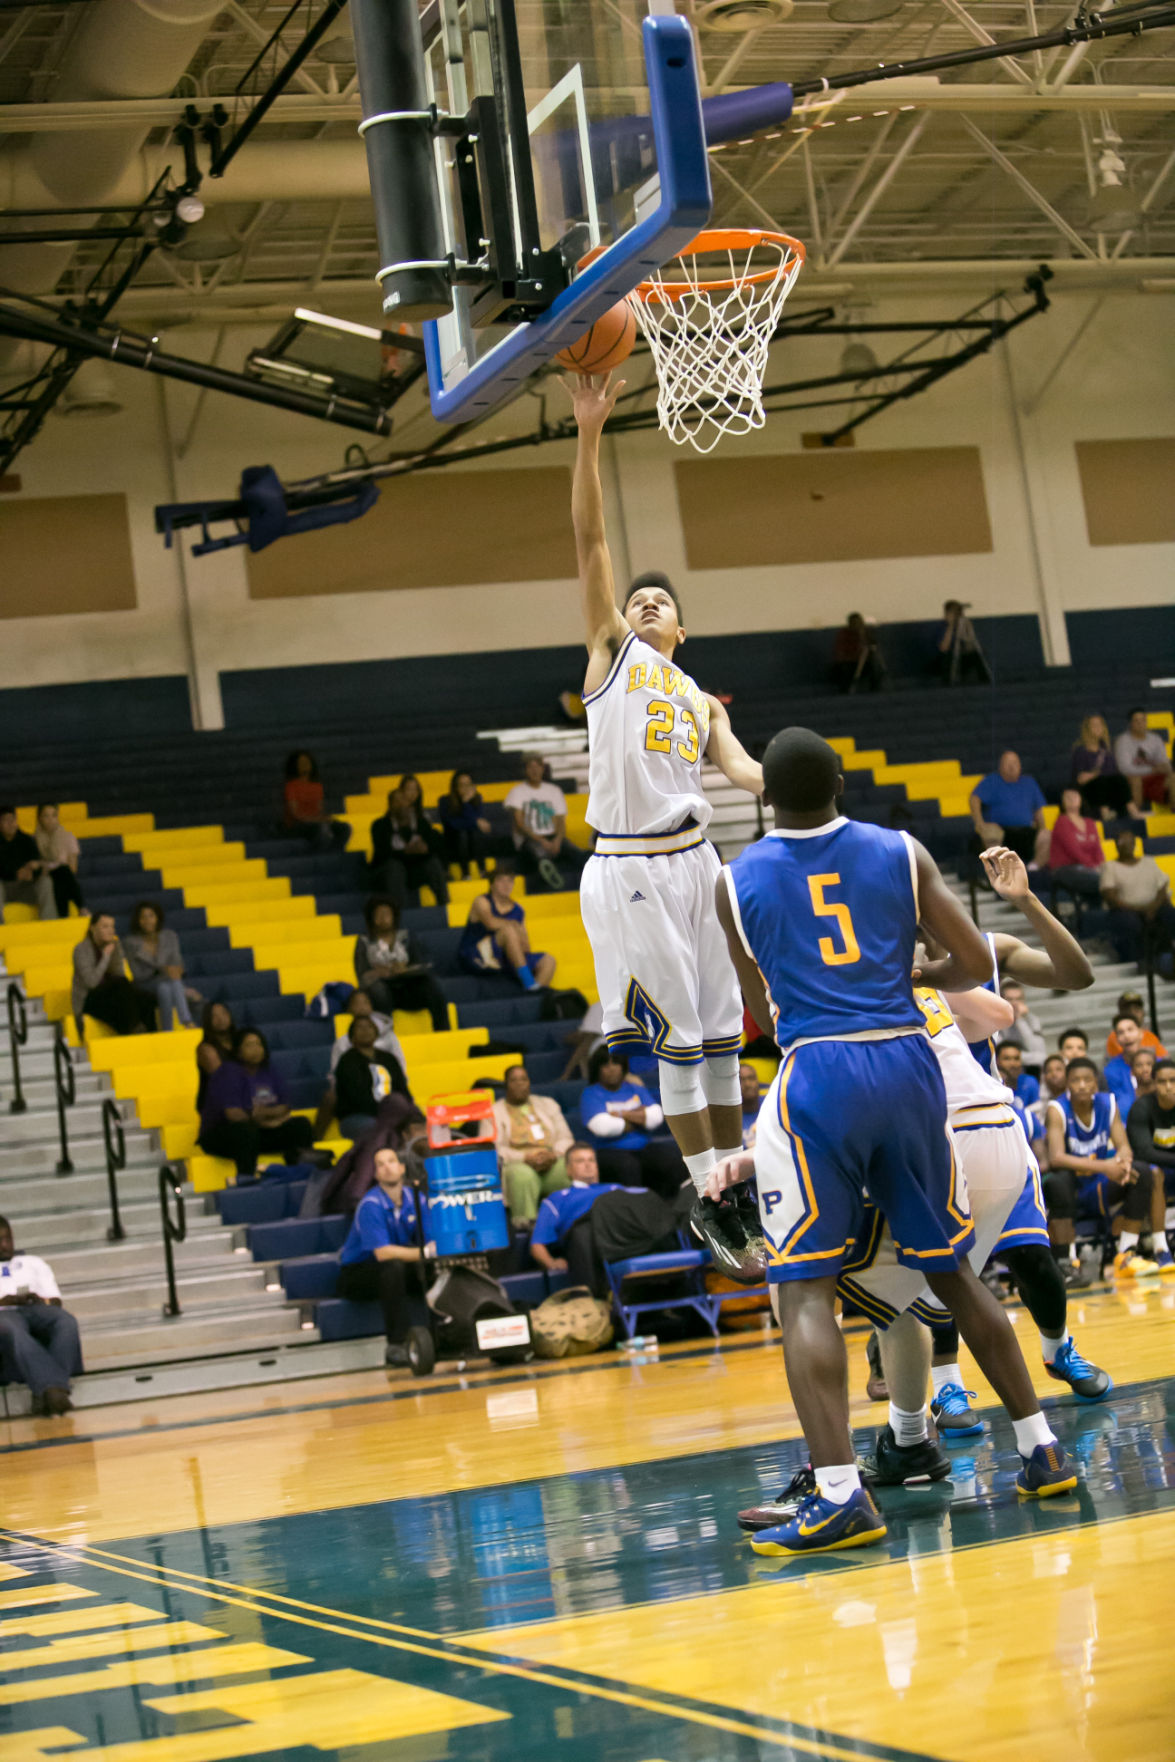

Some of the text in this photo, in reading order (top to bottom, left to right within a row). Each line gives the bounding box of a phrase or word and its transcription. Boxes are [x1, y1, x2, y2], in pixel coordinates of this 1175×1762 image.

[645, 699, 699, 764] 23
[807, 872, 861, 966] 5
[762, 1190, 783, 1216] P
